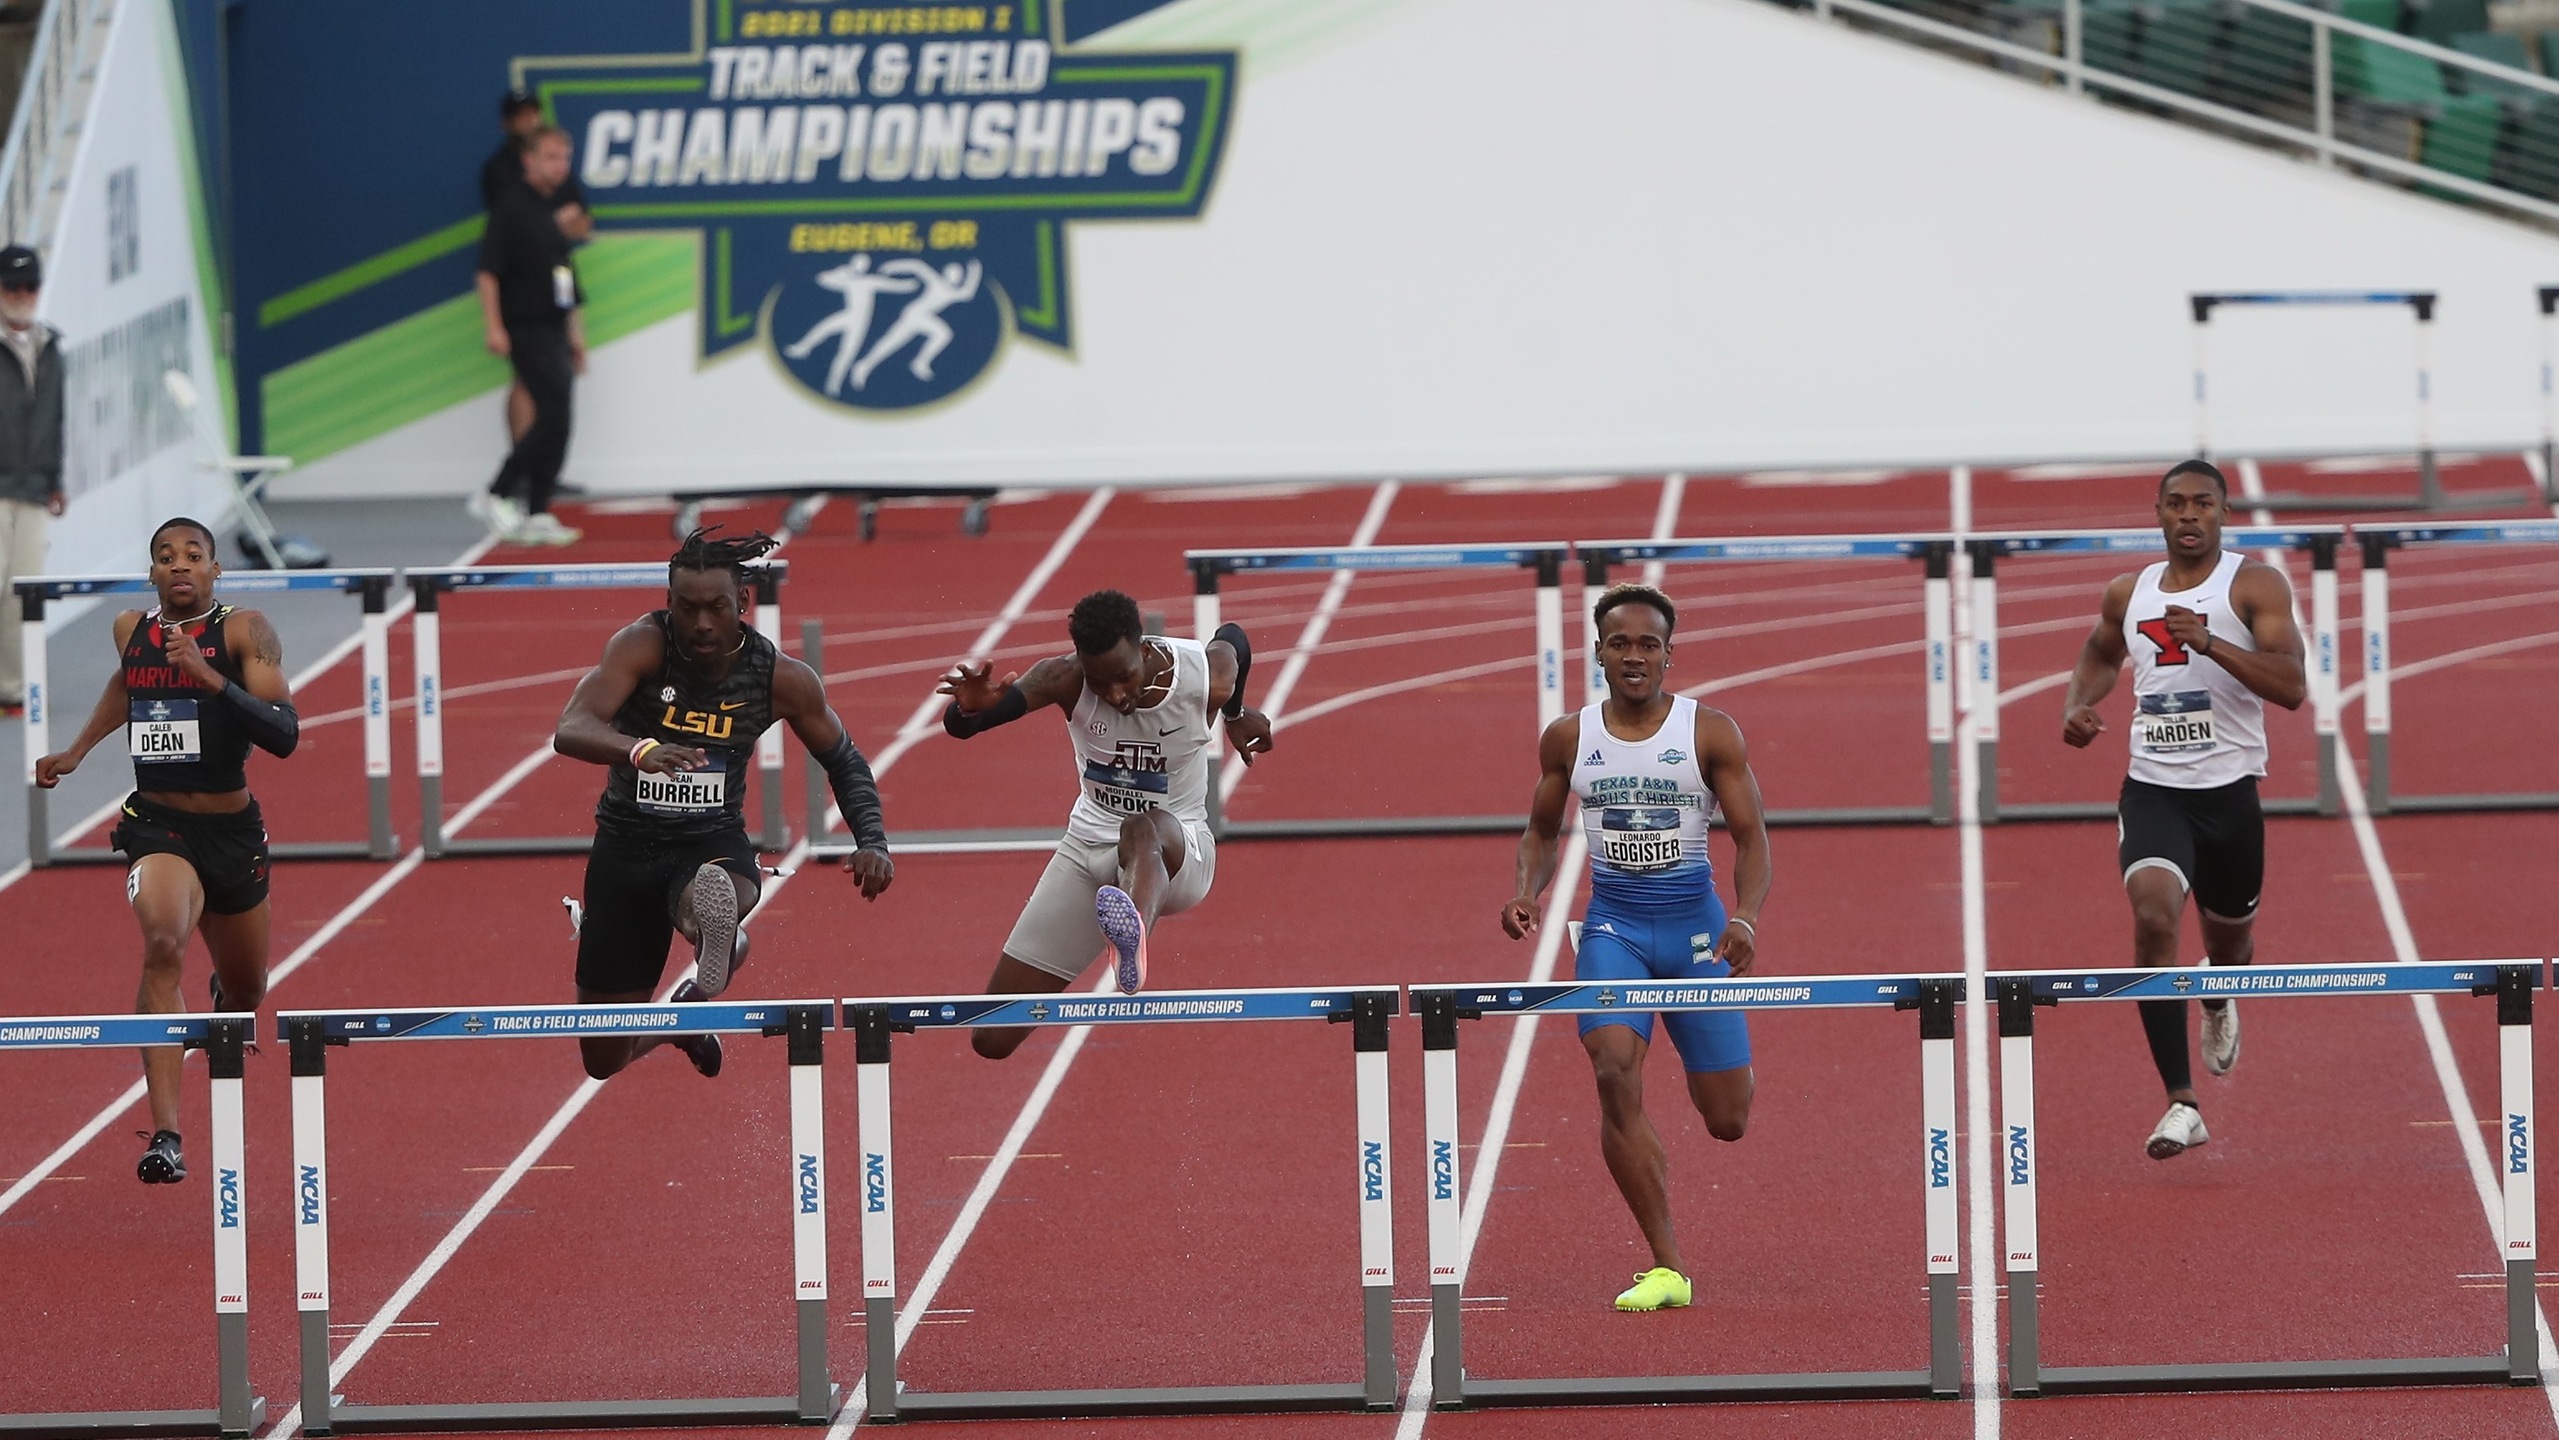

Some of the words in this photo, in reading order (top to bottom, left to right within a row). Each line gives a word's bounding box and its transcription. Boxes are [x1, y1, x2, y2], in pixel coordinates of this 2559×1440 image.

[740, 10, 822, 38] 2021
[830, 7, 986, 35] DIVISION
[708, 45, 866, 100] TRACK
[868, 42, 911, 97] &
[915, 40, 1050, 96] FIELD
[582, 98, 1185, 188] CHAMPIONSHIPS
[790, 222, 924, 253] EUGENE,
[928, 220, 979, 250] OR
[2137, 613, 2207, 667] Y
[127, 667, 204, 688] MARYLA
[150, 723, 172, 732] CALEB
[661, 705, 733, 739] LSU
[1091, 721, 1107, 736] SEC
[2146, 721, 2211, 743] HARDEN
[141, 733, 184, 752] DEAN
[638, 780, 722, 803] BURRELL
[1590, 776, 1638, 794] TEXAS
[1642, 776, 1679, 793] A&M
[1582, 791, 1630, 809] RPUS
[1634, 791, 1702, 809] CHRISTI
[1620, 833, 1661, 842] LEONARDO
[1604, 839, 1681, 862] LEDGISTER
[2201, 976, 2241, 990] TRACK
[2240, 976, 2251, 989] &
[2251, 975, 2284, 989] FIELD
[2286, 973, 2387, 989] CHAMPIONSHIPS
[2453, 972, 2474, 980] GILL
[1877, 985, 1898, 994] GILL
[2052, 981, 2073, 990] GILL
[1310, 999, 1331, 1008] GILL
[1476, 994, 1497, 1003] GILL
[1625, 990, 1663, 1004] TRACK
[1664, 990, 1675, 1003] &
[1675, 989, 1709, 1003] FIELD
[1710, 987, 1811, 1003] CHAMPIONSHIPS
[744, 1012, 765, 1020] GILL
[909, 1009, 930, 1018] GILL
[1058, 1003, 1096, 1018] TRACK
[1097, 1003, 1108, 1017] &
[1108, 1002, 1141, 1017] FIELD
[1143, 1000, 1244, 1015] CHAMPIONSHIPS
[166, 1026, 187, 1034] GILL
[344, 1021, 365, 1029] GILL
[493, 1016, 531, 1030] TRACK
[532, 1016, 543, 1029] &
[542, 1015, 576, 1029] FIELD
[577, 1013, 678, 1028] CHAMPIONSHIPS
[0, 1026, 101, 1041] CHAMPIONSHIPS
[2510, 1114, 2528, 1174] NCAA
[1931, 1128, 1950, 1188] NCAA
[2010, 1125, 2029, 1185] NCAA
[1364, 1140, 1384, 1201] NCAA
[1434, 1140, 1453, 1200] NCAA
[800, 1154, 819, 1214] NCAA
[867, 1153, 886, 1213] NCAA
[220, 1169, 239, 1228] NCAA
[301, 1165, 320, 1225] NCAA
[2508, 1241, 2531, 1249] GILL
[1932, 1254, 1953, 1264] GILL
[2010, 1252, 2033, 1262] GILL
[1365, 1267, 1387, 1277] GILL
[1433, 1266, 1455, 1276] GILL
[800, 1280, 822, 1289] GILL
[867, 1280, 889, 1288] GILL
[220, 1295, 242, 1304] GILL
[301, 1291, 324, 1301] GILL
